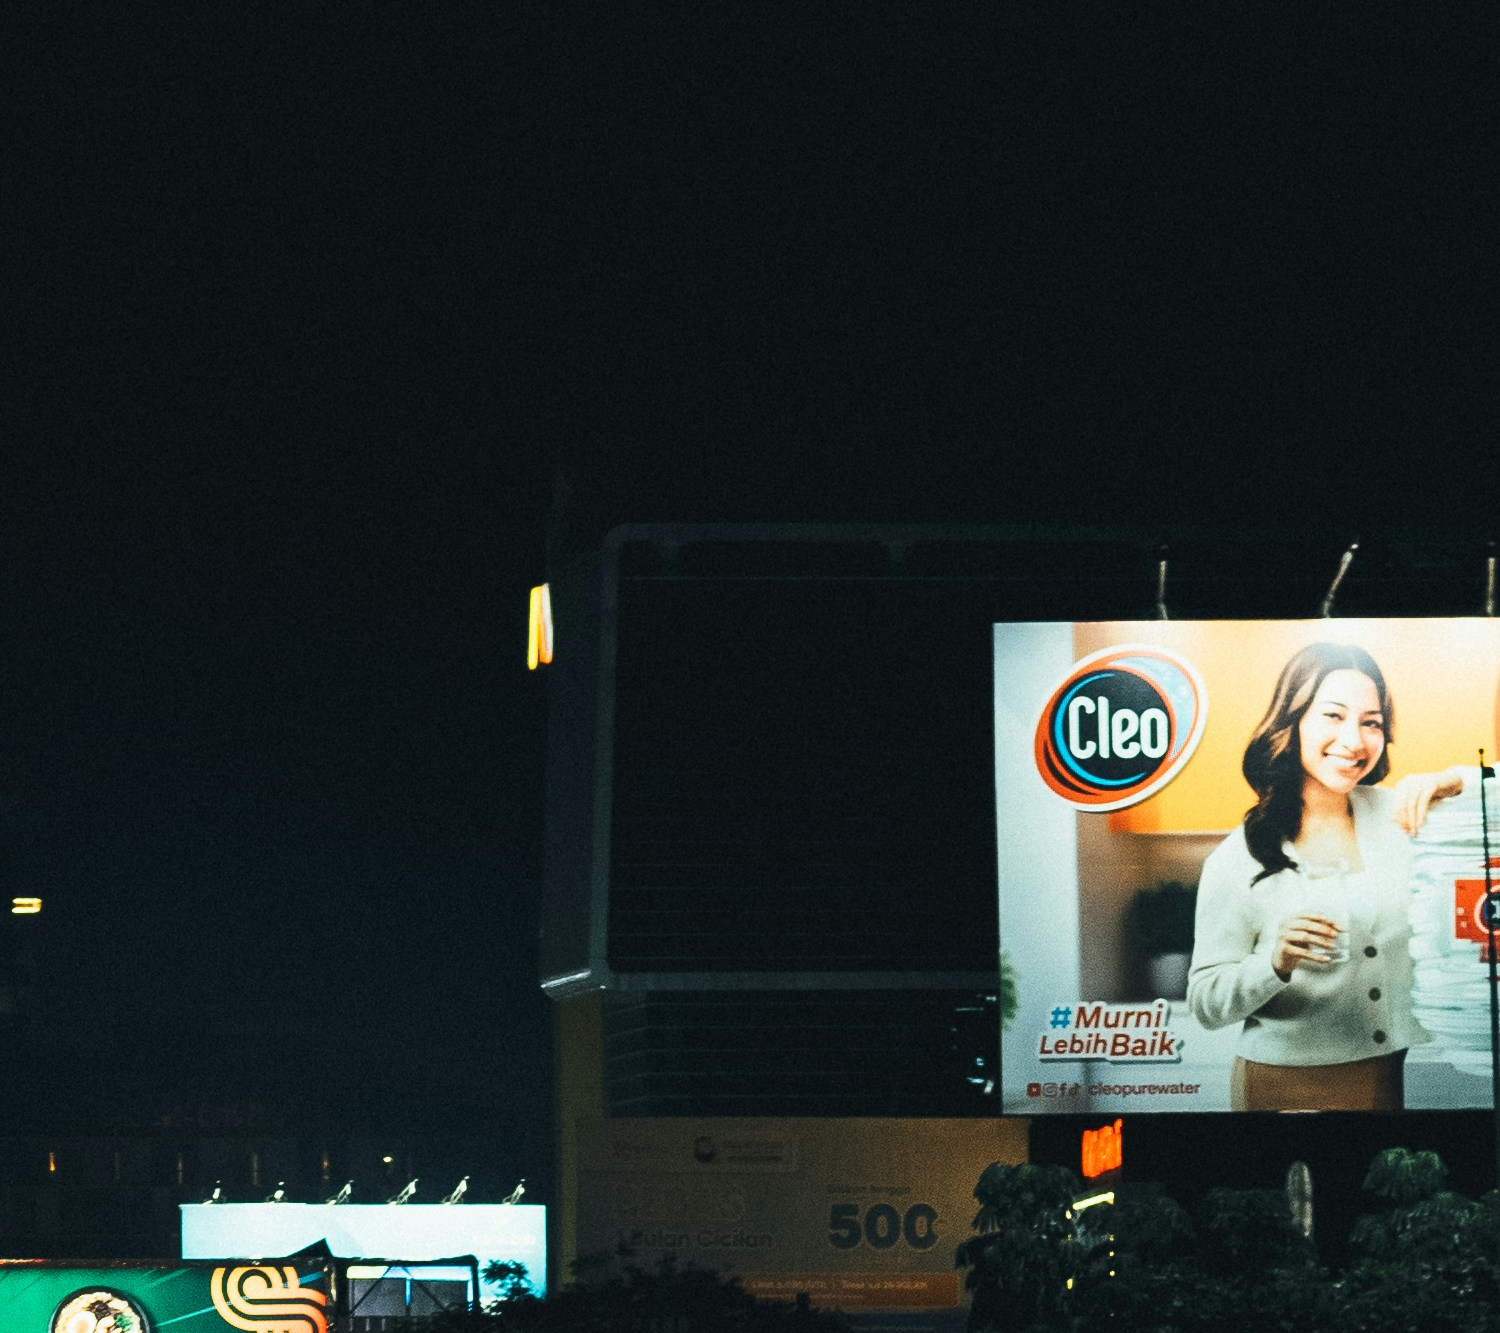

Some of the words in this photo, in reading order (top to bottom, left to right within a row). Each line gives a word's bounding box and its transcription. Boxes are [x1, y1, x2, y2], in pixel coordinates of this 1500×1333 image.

[1068, 695, 1170, 760] Cleo
[1049, 1003, 1164, 1028] #Murni
[1088, 1082, 1201, 1098] cleopurewater
[696, 1228, 773, 1247] Cicilan
